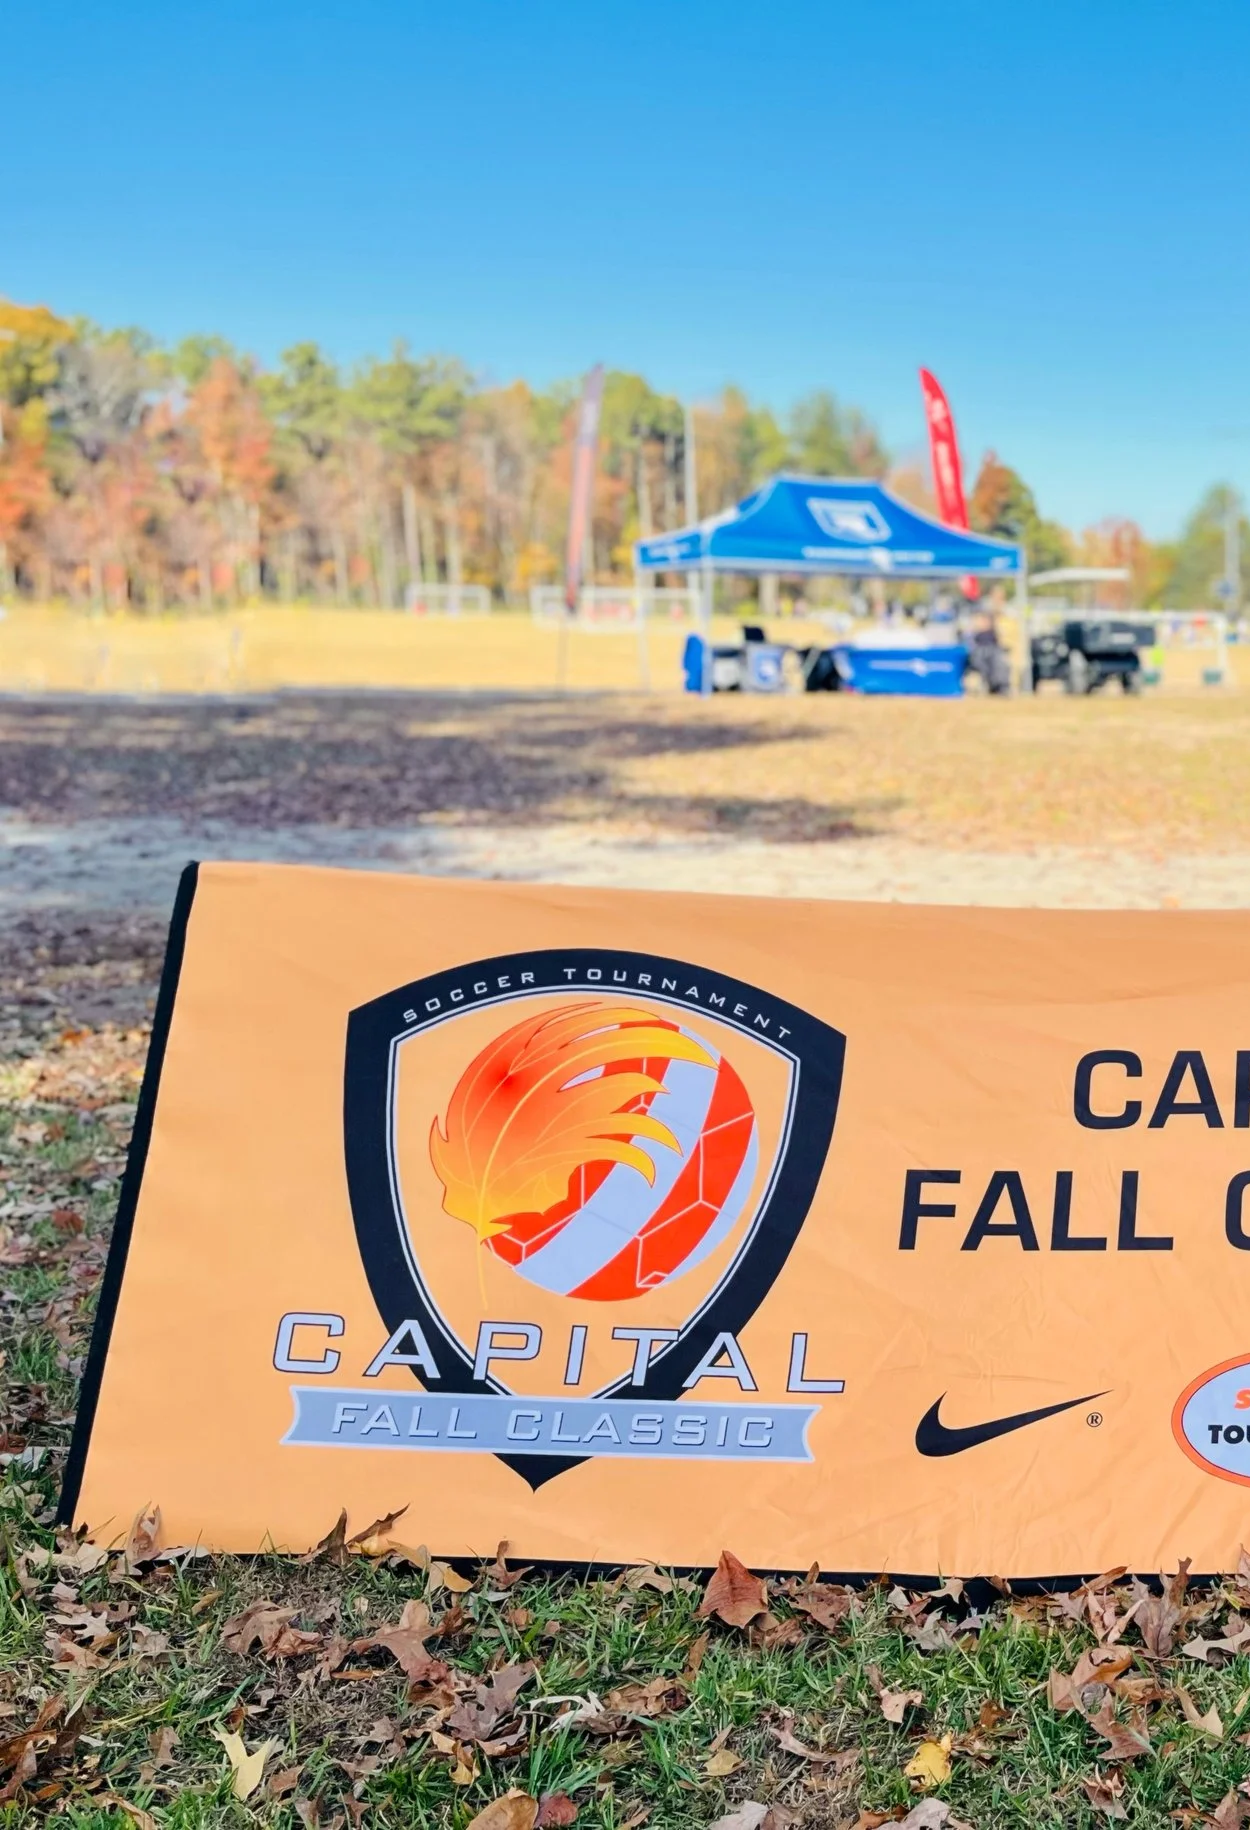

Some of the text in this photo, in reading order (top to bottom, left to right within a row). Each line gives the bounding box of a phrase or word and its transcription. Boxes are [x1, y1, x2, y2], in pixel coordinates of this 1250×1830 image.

[402, 967, 792, 1041] SOCCER TOURNAMENT
[898, 1169, 1174, 1252] FALL
[272, 1311, 846, 1394] CAPITAL
[330, 1402, 775, 1448] FALL CLASSIC
